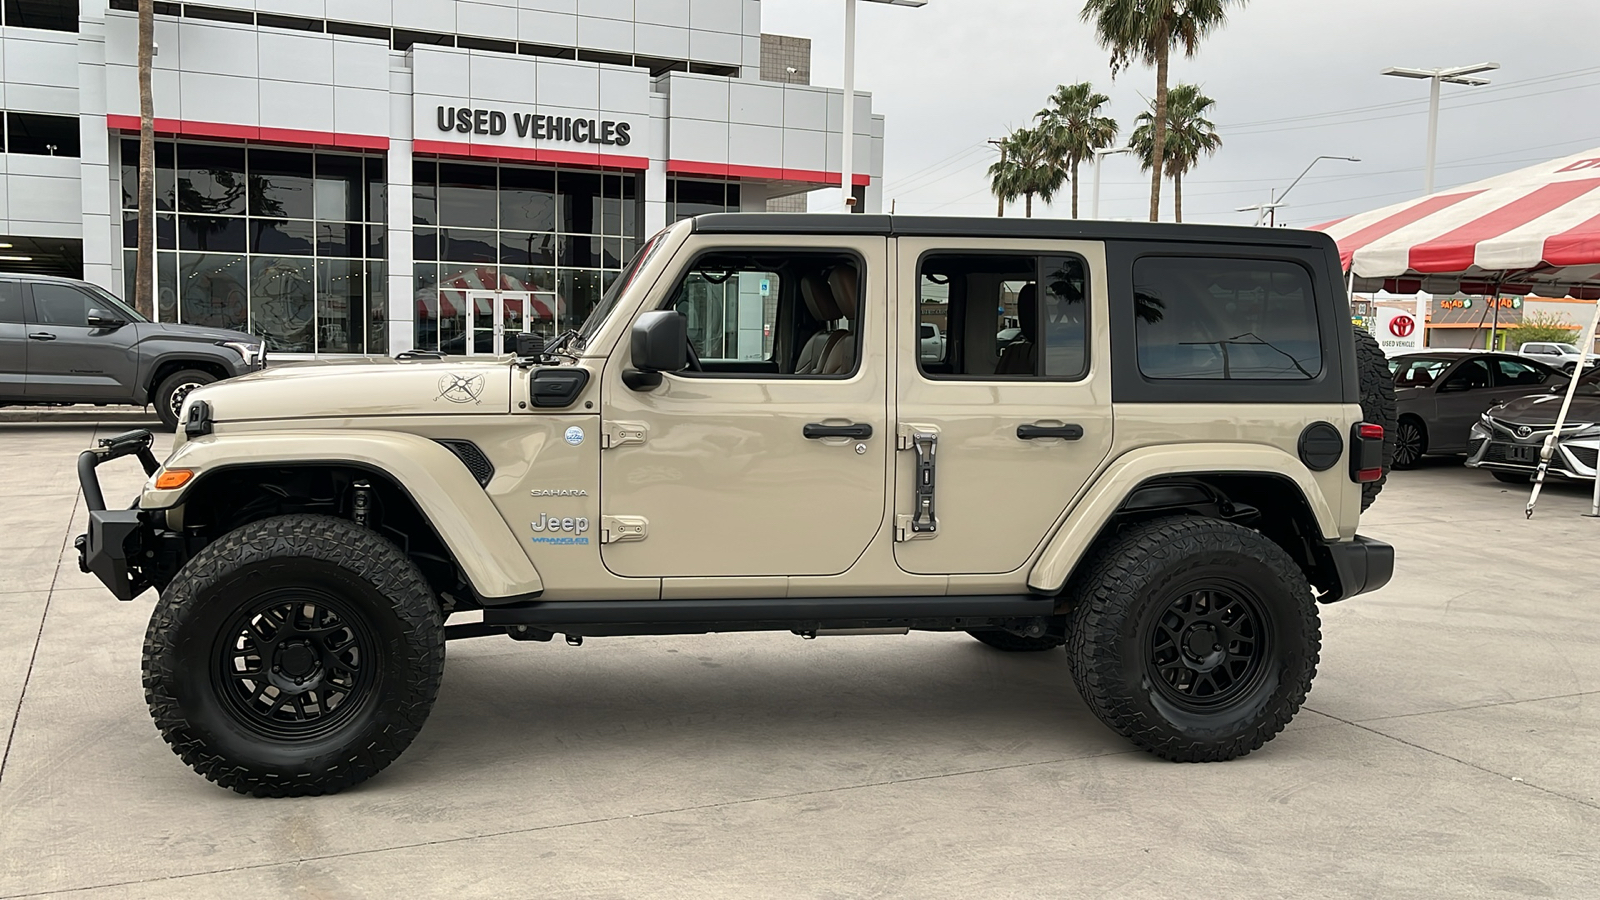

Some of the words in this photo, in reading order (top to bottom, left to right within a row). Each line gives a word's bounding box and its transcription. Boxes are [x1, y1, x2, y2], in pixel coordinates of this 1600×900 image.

[437, 106, 507, 136] USED
[513, 112, 631, 146] VEHICLES
[530, 489, 588, 497] SAHARA
[530, 512, 589, 535] Jeep
